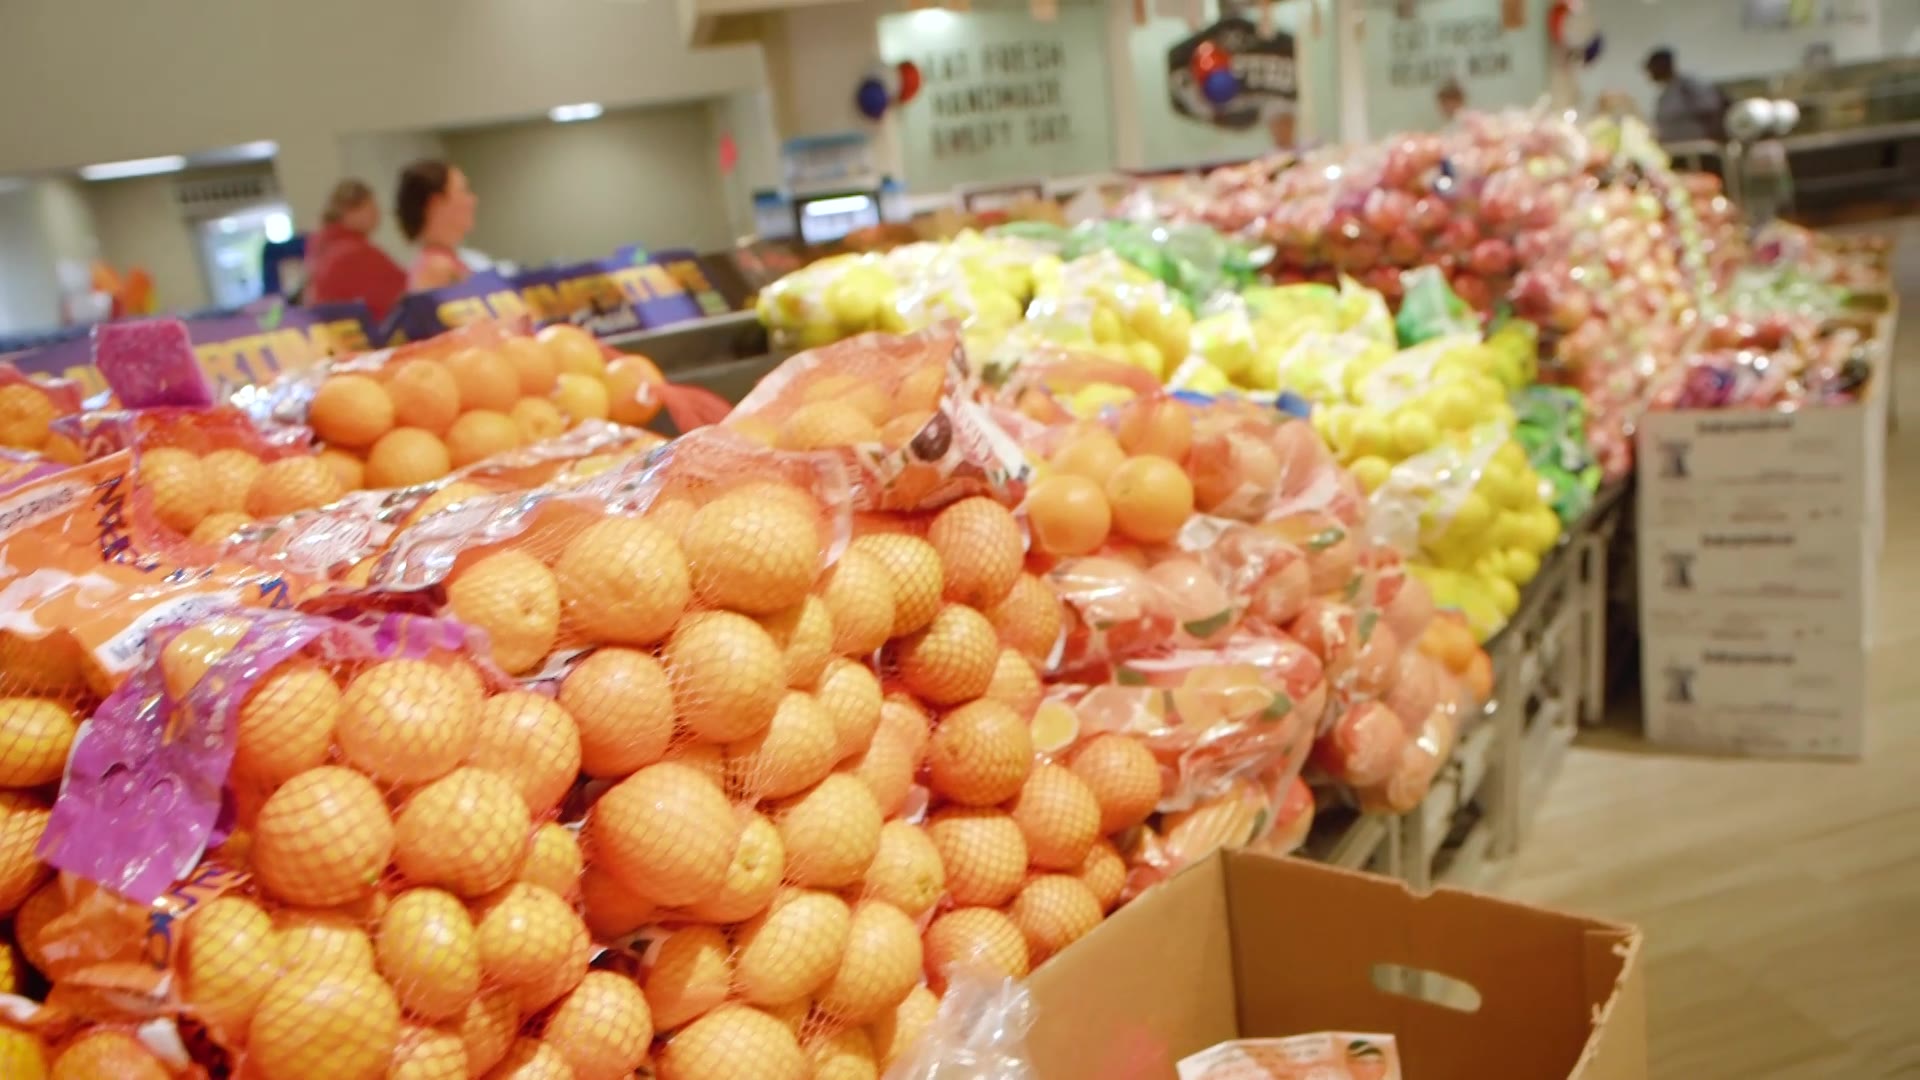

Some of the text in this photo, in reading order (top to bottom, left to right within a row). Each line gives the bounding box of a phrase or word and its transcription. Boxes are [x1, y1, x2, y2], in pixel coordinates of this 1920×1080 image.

[981, 40, 1066, 74] FRESH
[932, 80, 1061, 117] HANDMADE
[930, 119, 1012, 157] EVERY
